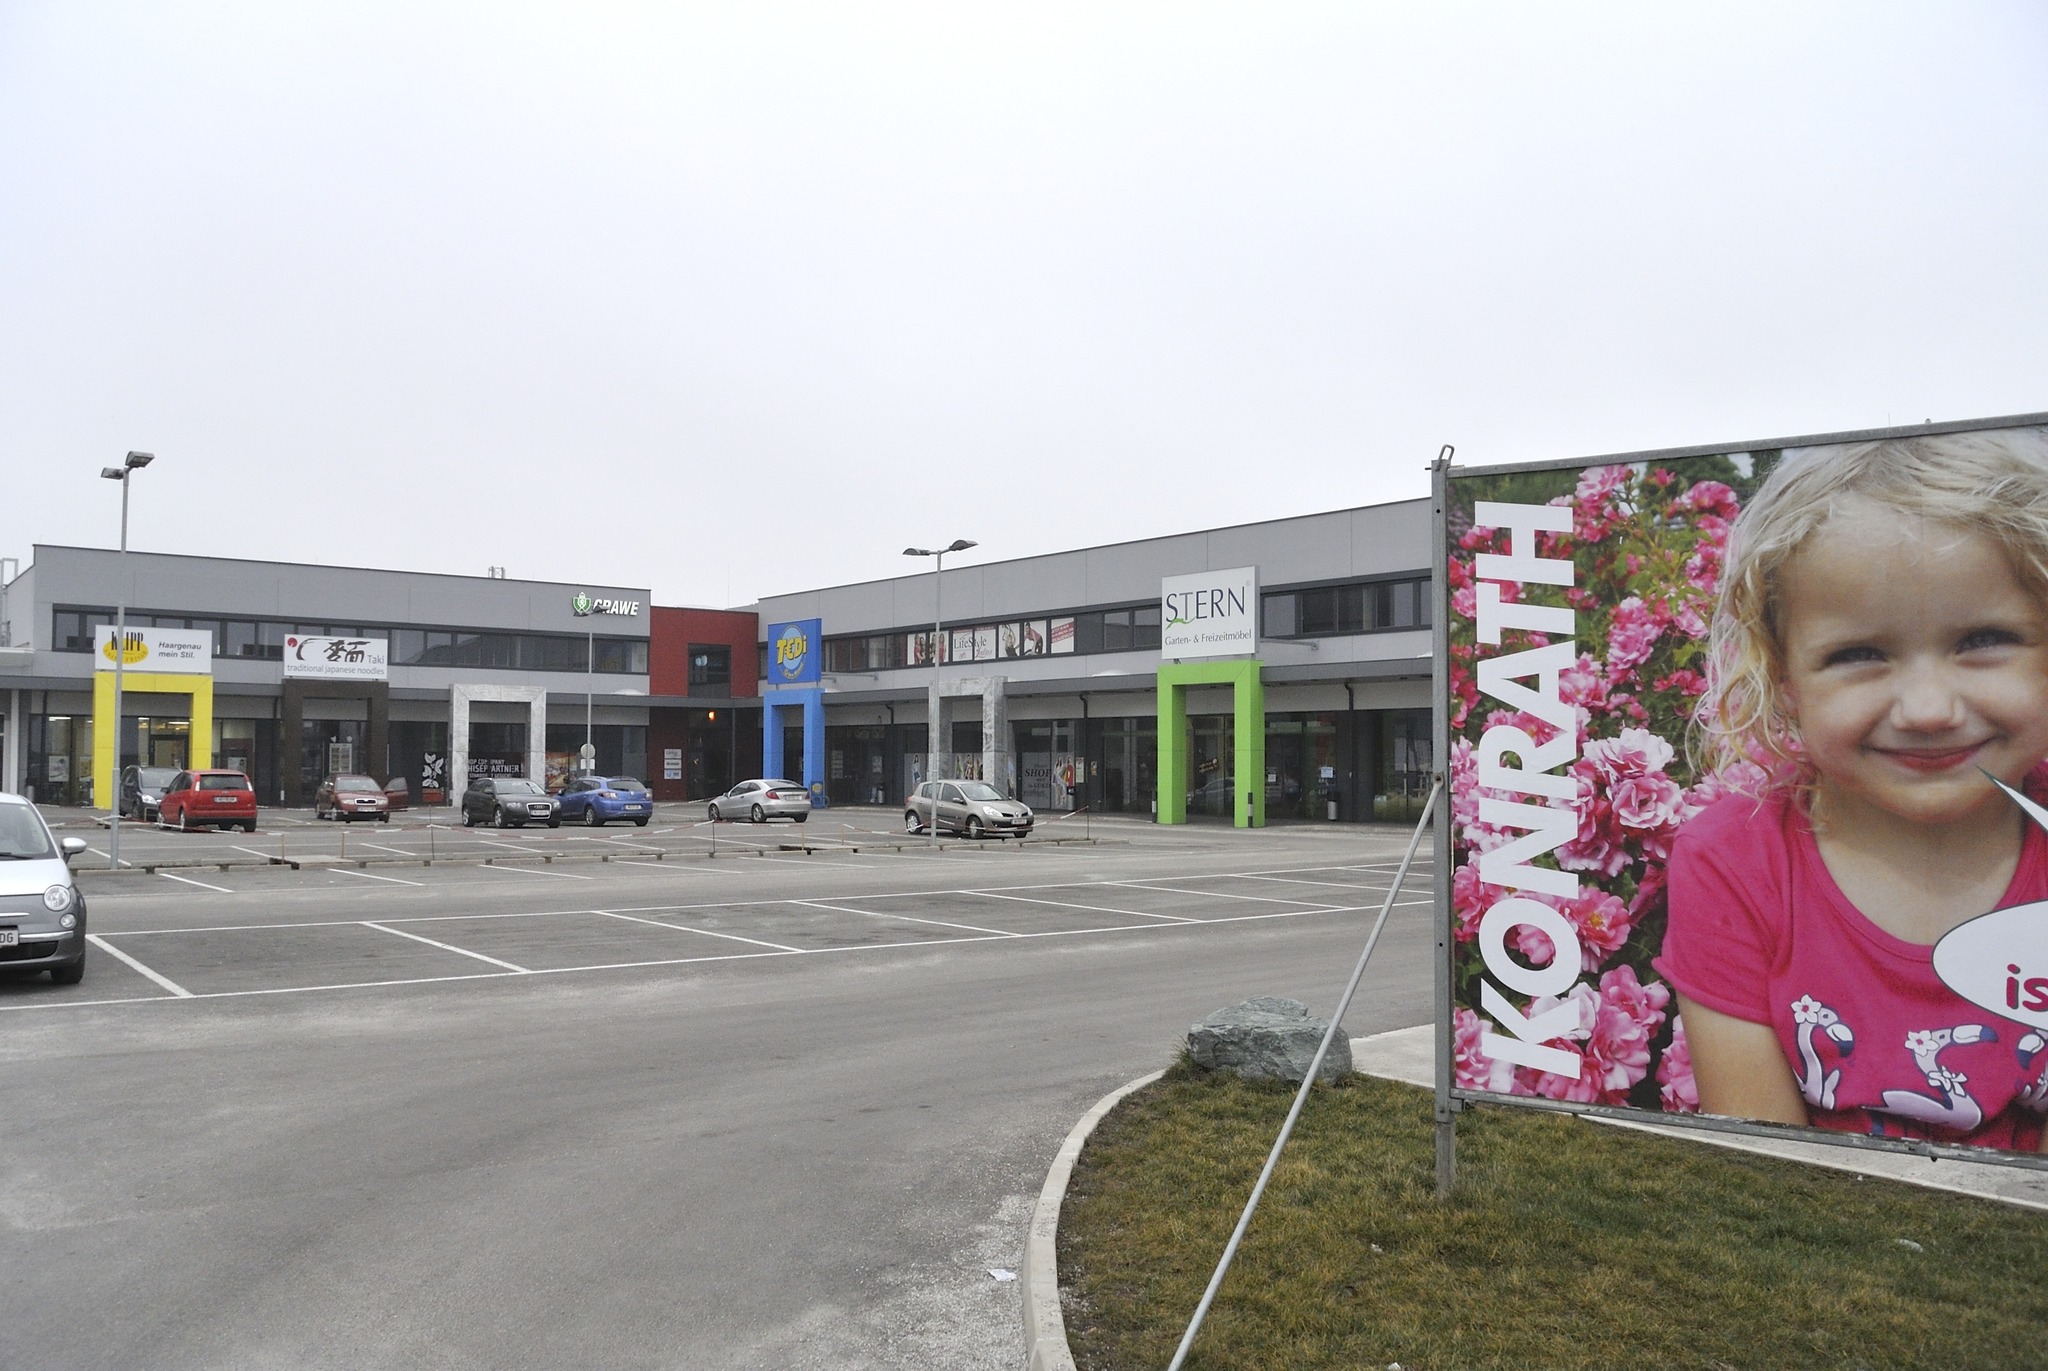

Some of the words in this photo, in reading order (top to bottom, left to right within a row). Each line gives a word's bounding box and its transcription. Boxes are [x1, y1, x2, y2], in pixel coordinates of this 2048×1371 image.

[1166, 586, 1244, 623] STERN
[111, 631, 144, 651] KIPP
[158, 641, 202, 651] Haargenau
[1165, 635, 1191, 646] Garten-
[1193, 634, 1199, 643] &
[1201, 629, 1252, 643] Freizeitmöbel
[367, 655, 385, 665] Taki
[287, 664, 324, 673] traditional
[325, 666, 356, 675] japanese
[357, 667, 385, 676] noodles
[1475, 501, 1581, 1079] KONRATH
[2006, 964, 2048, 1012] is
